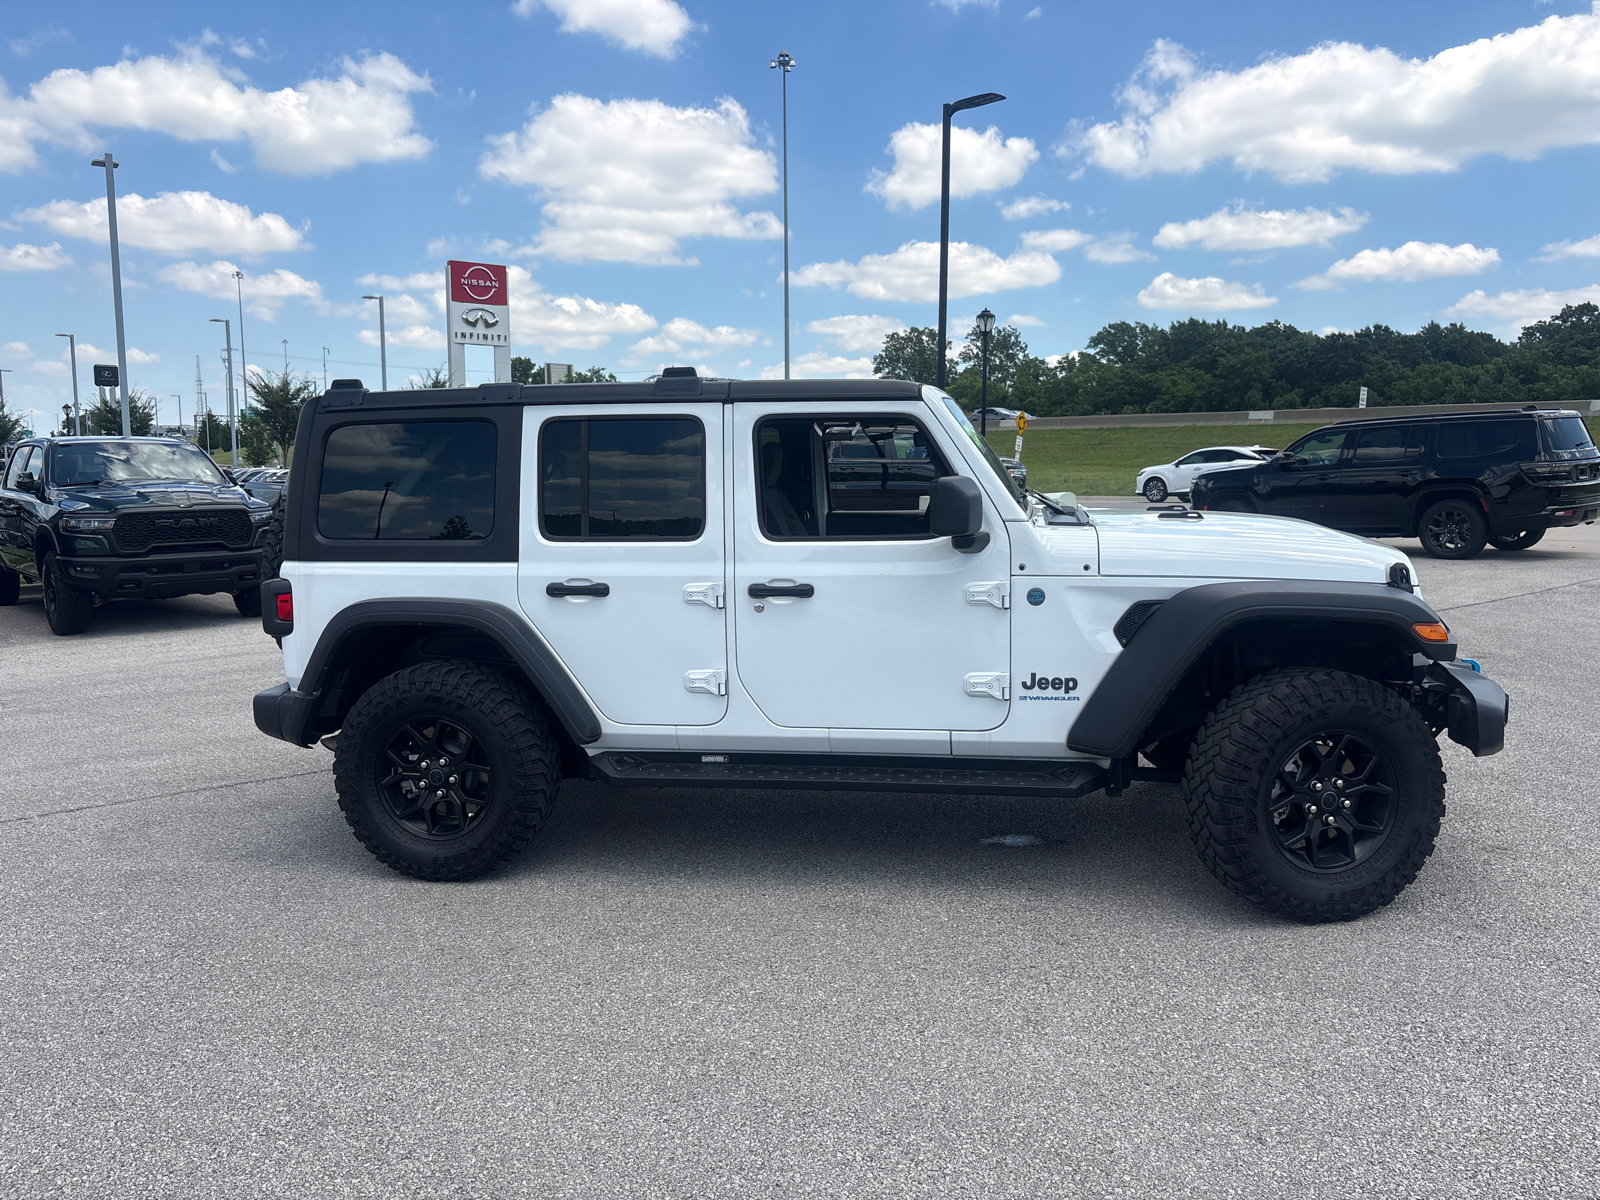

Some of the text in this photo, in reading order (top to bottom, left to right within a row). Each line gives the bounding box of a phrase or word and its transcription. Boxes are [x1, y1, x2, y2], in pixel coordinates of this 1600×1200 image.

[461, 278, 499, 288] NISSAN
[455, 331, 507, 342] INFINITI
[154, 518, 218, 528] RAM
[1021, 672, 1078, 694] Jeep
